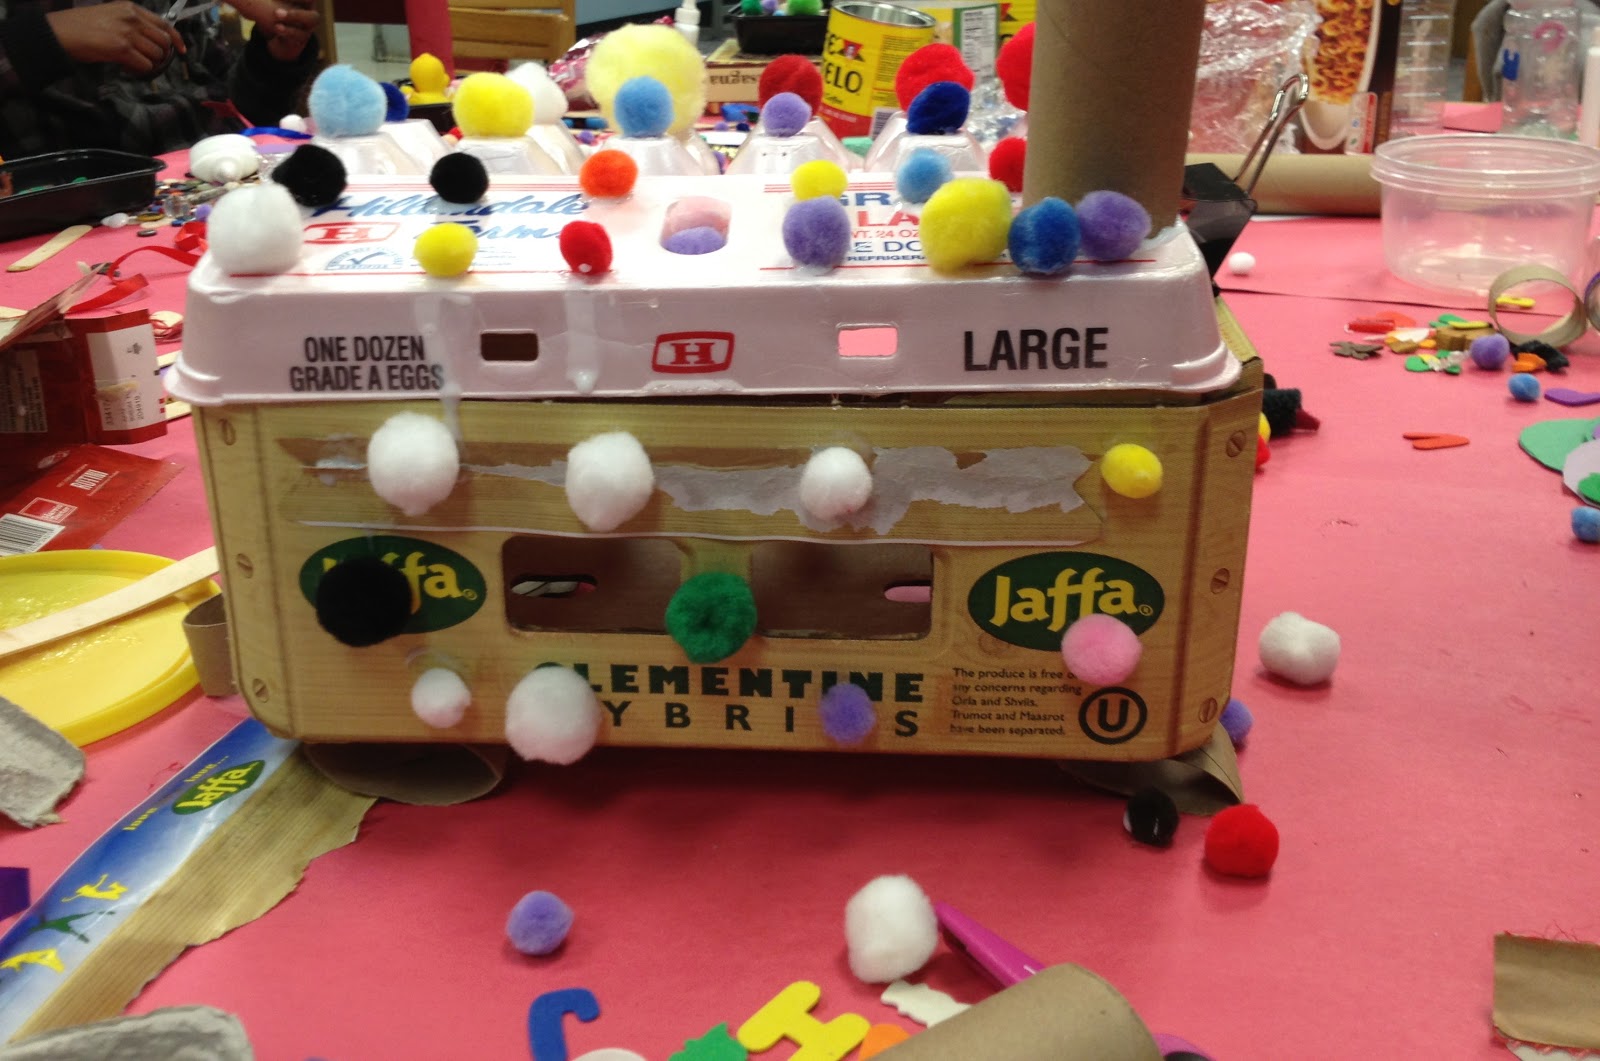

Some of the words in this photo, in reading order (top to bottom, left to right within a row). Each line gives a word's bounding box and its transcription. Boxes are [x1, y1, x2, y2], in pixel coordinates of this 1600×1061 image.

[824, 62, 863, 93] ELO
[857, 211, 922, 227] LA
[304, 336, 347, 362] ONE
[354, 335, 425, 361] DOZEN
[964, 327, 1109, 372] LARGE
[289, 366, 363, 391] GRADE
[367, 365, 384, 390] A
[387, 364, 444, 391] EGGS
[989, 567, 1139, 632] Jaffa
[953, 667, 974, 678] The
[978, 668, 1025, 680] produce
[1029, 669, 1037, 678] is
[1041, 669, 1063, 679] free
[974, 684, 1026, 693] concerns
[1030, 684, 1082, 696] regarding
[981, 697, 1001, 706] and
[951, 709, 992, 720] Trumot
[996, 711, 1016, 720] and
[950, 723, 974, 734] have
[978, 724, 1005, 735] been
[175, 763, 252, 809] Jaffa
